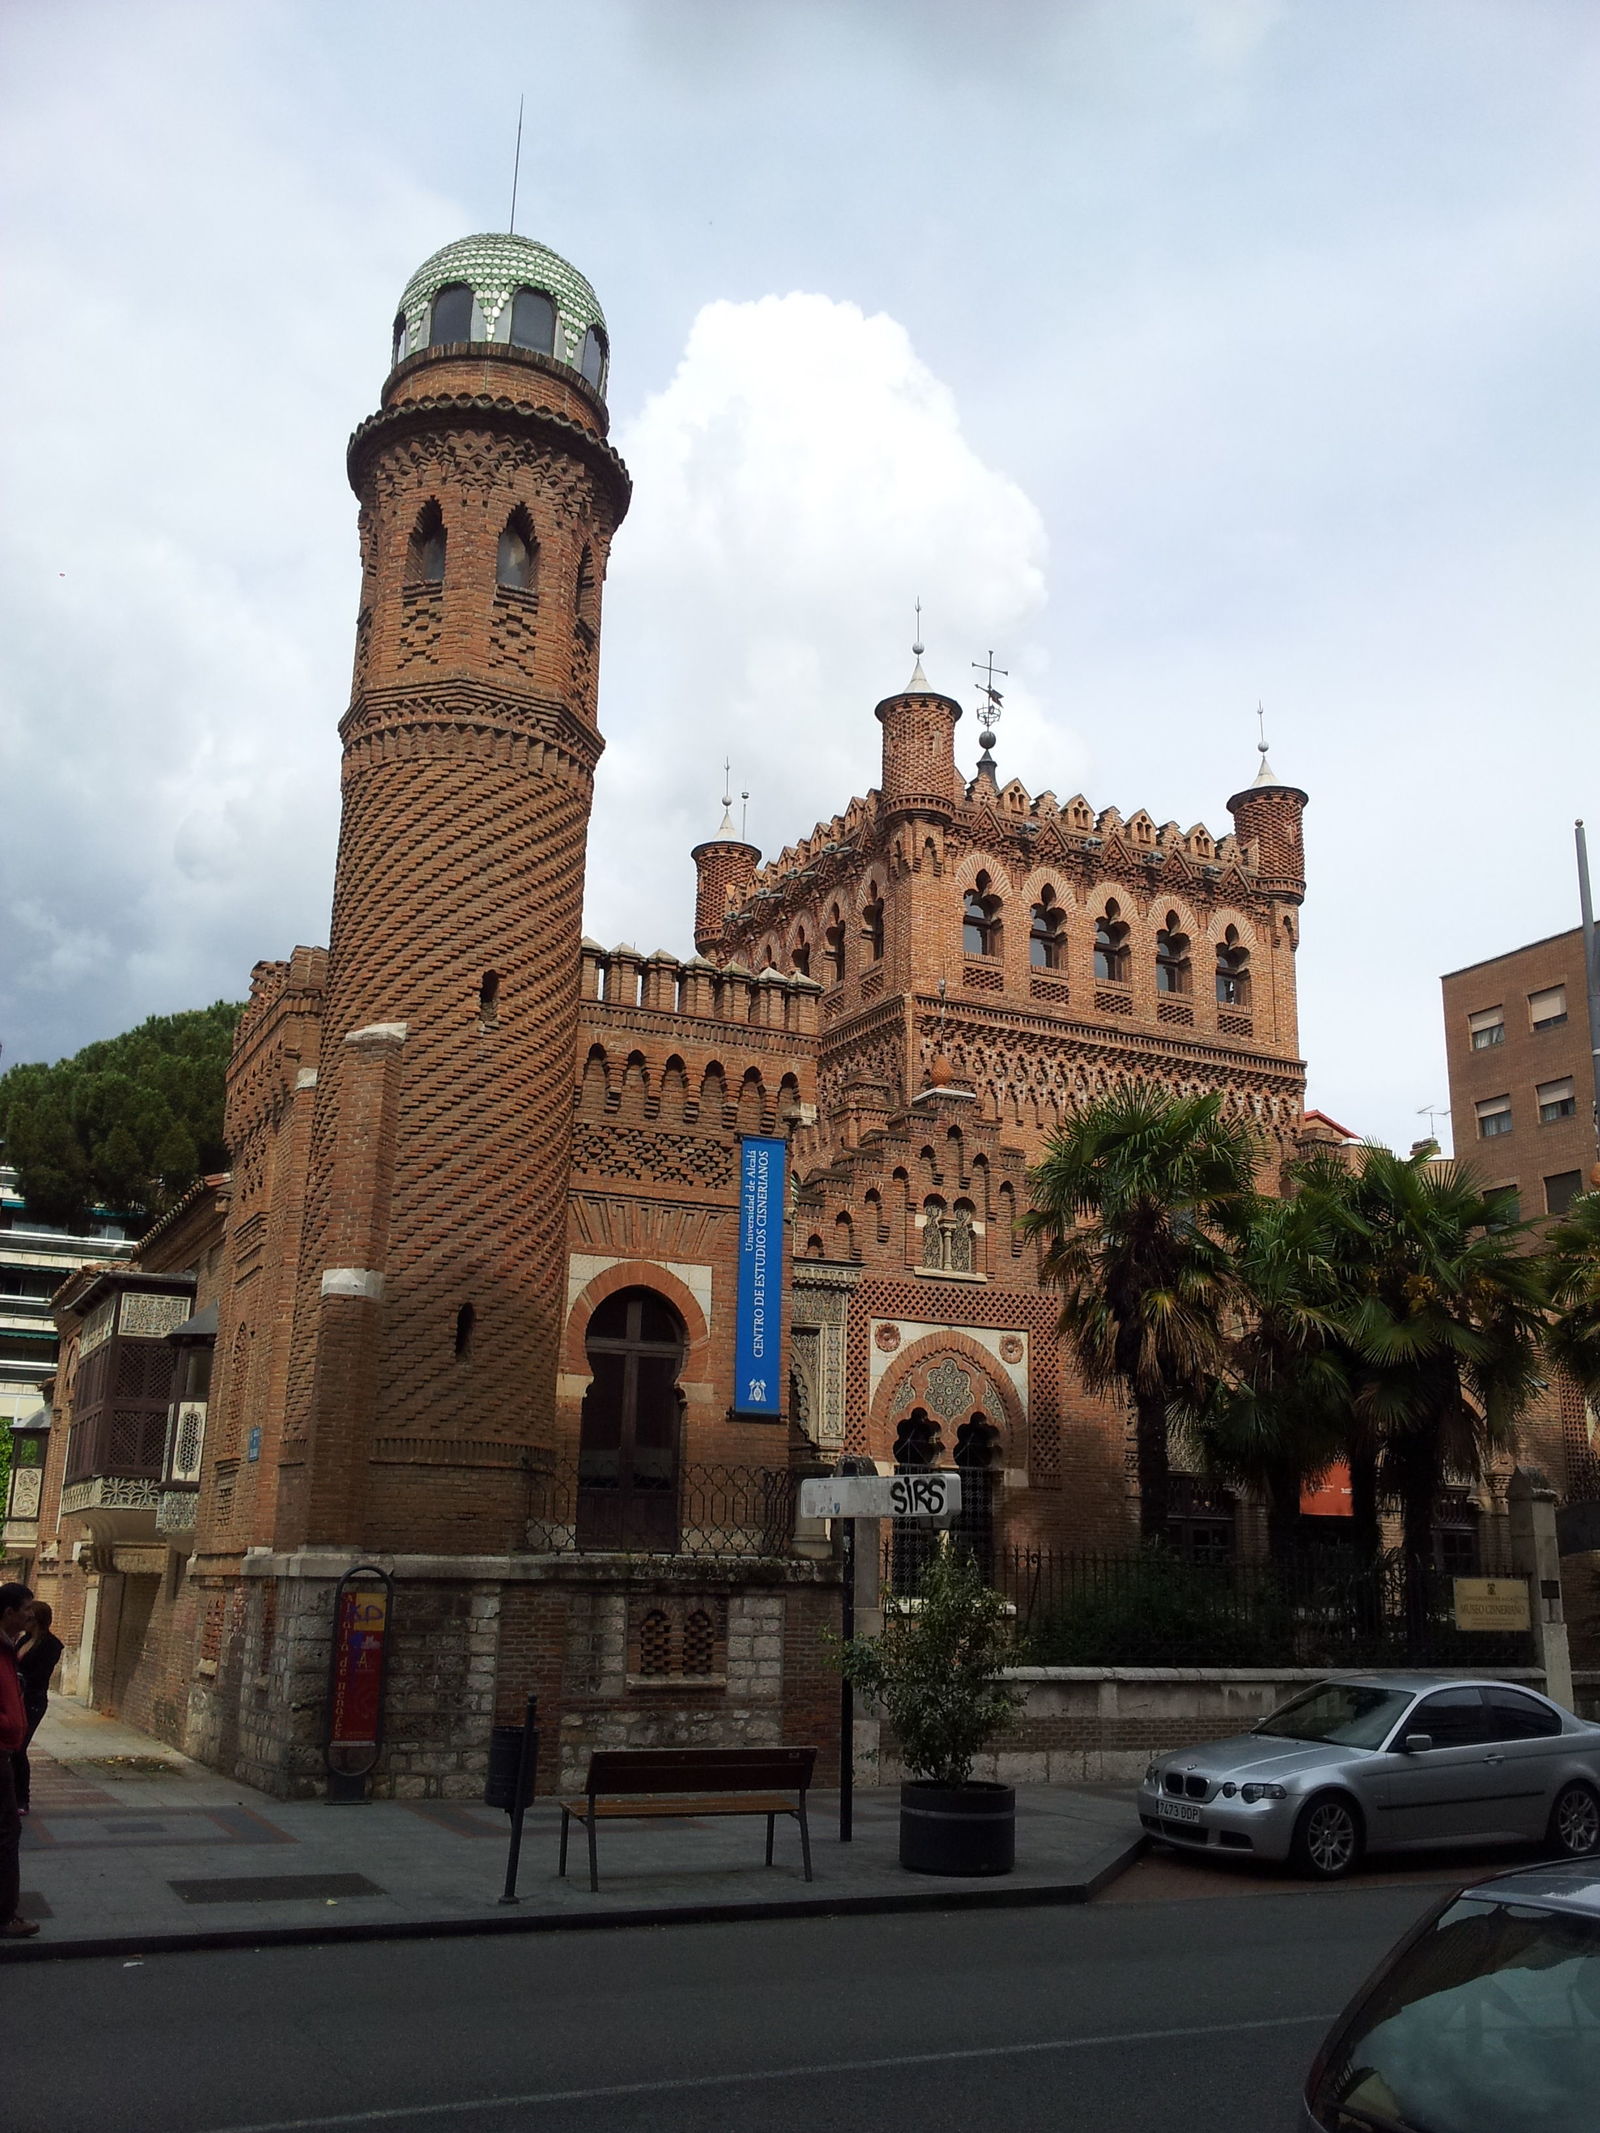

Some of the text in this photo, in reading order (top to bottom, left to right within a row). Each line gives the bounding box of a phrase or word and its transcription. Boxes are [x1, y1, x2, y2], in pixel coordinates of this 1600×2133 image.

[745, 1150, 757, 1252] Universidad de Alcalá
[753, 1151, 769, 1358] CENTRO DE ESTUDIOS CISNERIANOS
[1160, 1802, 1179, 1817] 7473
